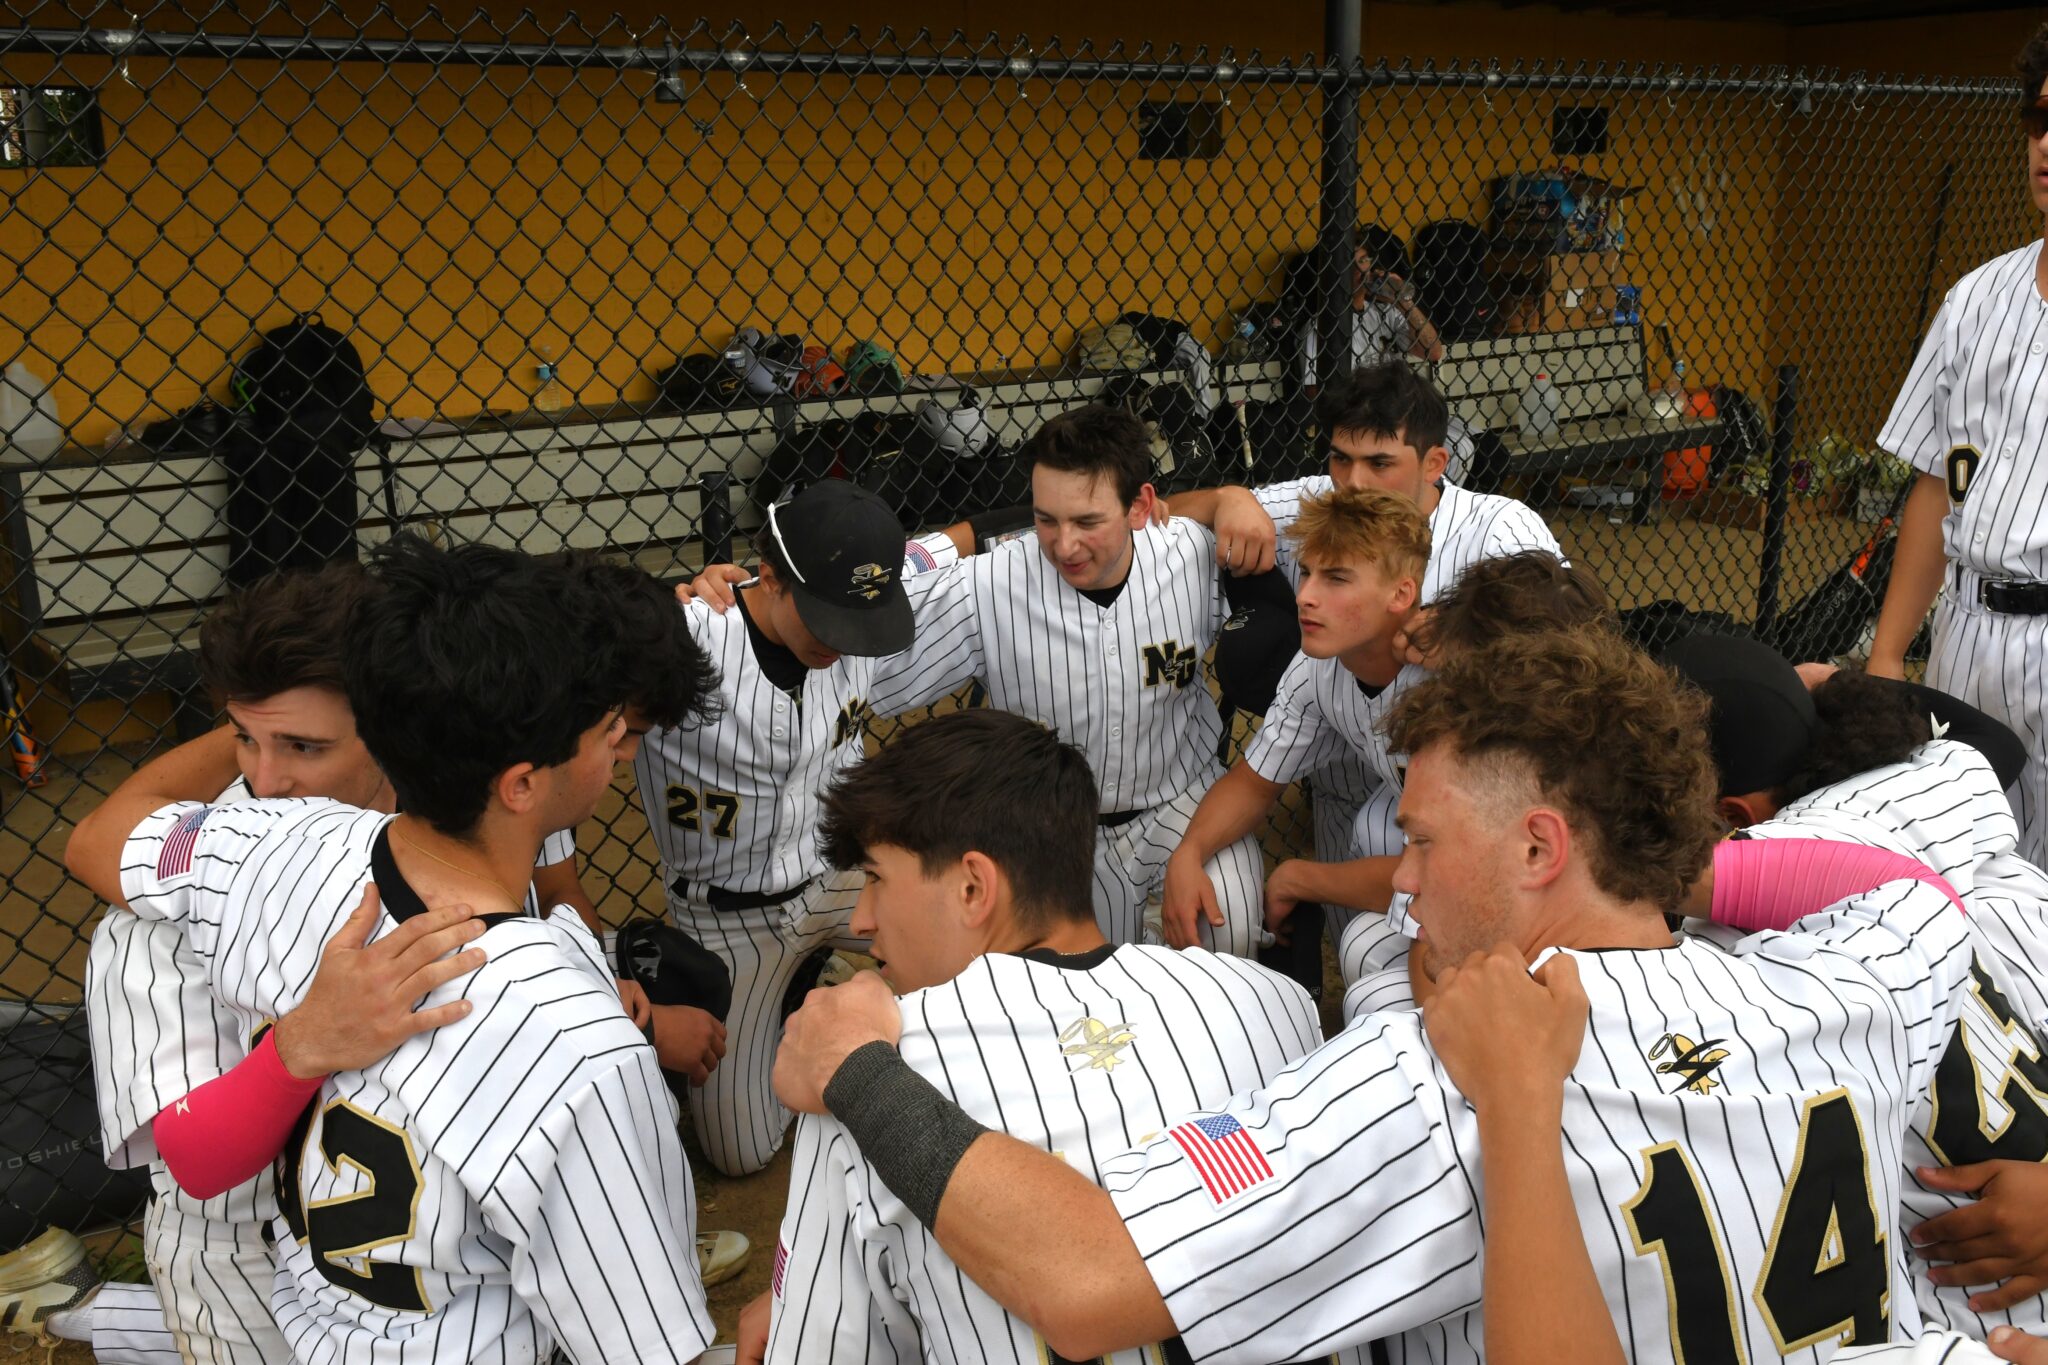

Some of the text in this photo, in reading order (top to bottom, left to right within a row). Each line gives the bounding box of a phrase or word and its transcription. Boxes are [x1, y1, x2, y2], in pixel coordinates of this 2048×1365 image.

[666, 783, 739, 840] 27
[0, 1134, 102, 1170] OSHIEL
[1619, 1086, 1891, 1365] 14
